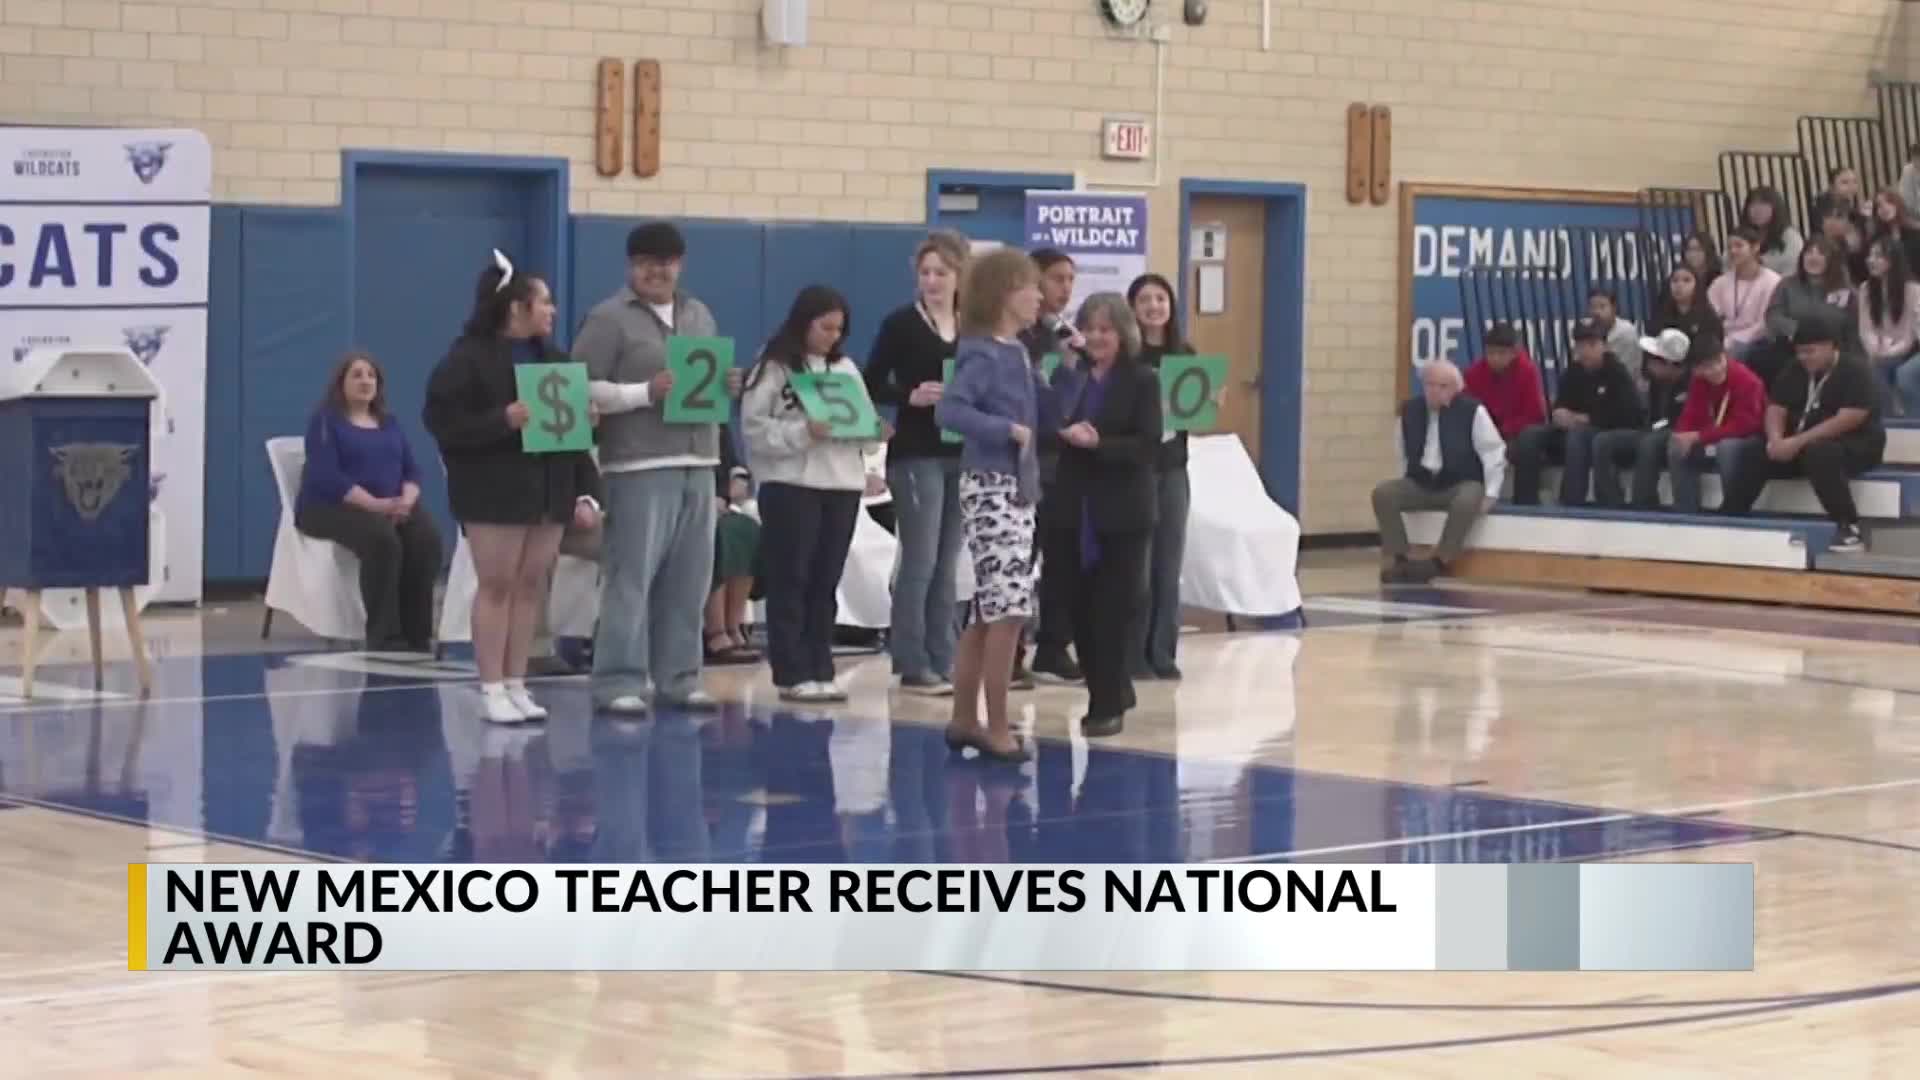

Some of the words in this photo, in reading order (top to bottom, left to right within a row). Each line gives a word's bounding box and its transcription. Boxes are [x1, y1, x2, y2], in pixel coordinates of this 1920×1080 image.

[1117, 125, 1143, 152] EXIT
[13, 160, 80, 176] WILDCATS
[1038, 205, 1134, 224] PORTRAIT
[1051, 227, 1139, 247] WILDCAT
[1413, 224, 1572, 279] DEMAND
[680, 349, 717, 408] 2
[536, 370, 577, 443] $
[815, 380, 859, 424] 5
